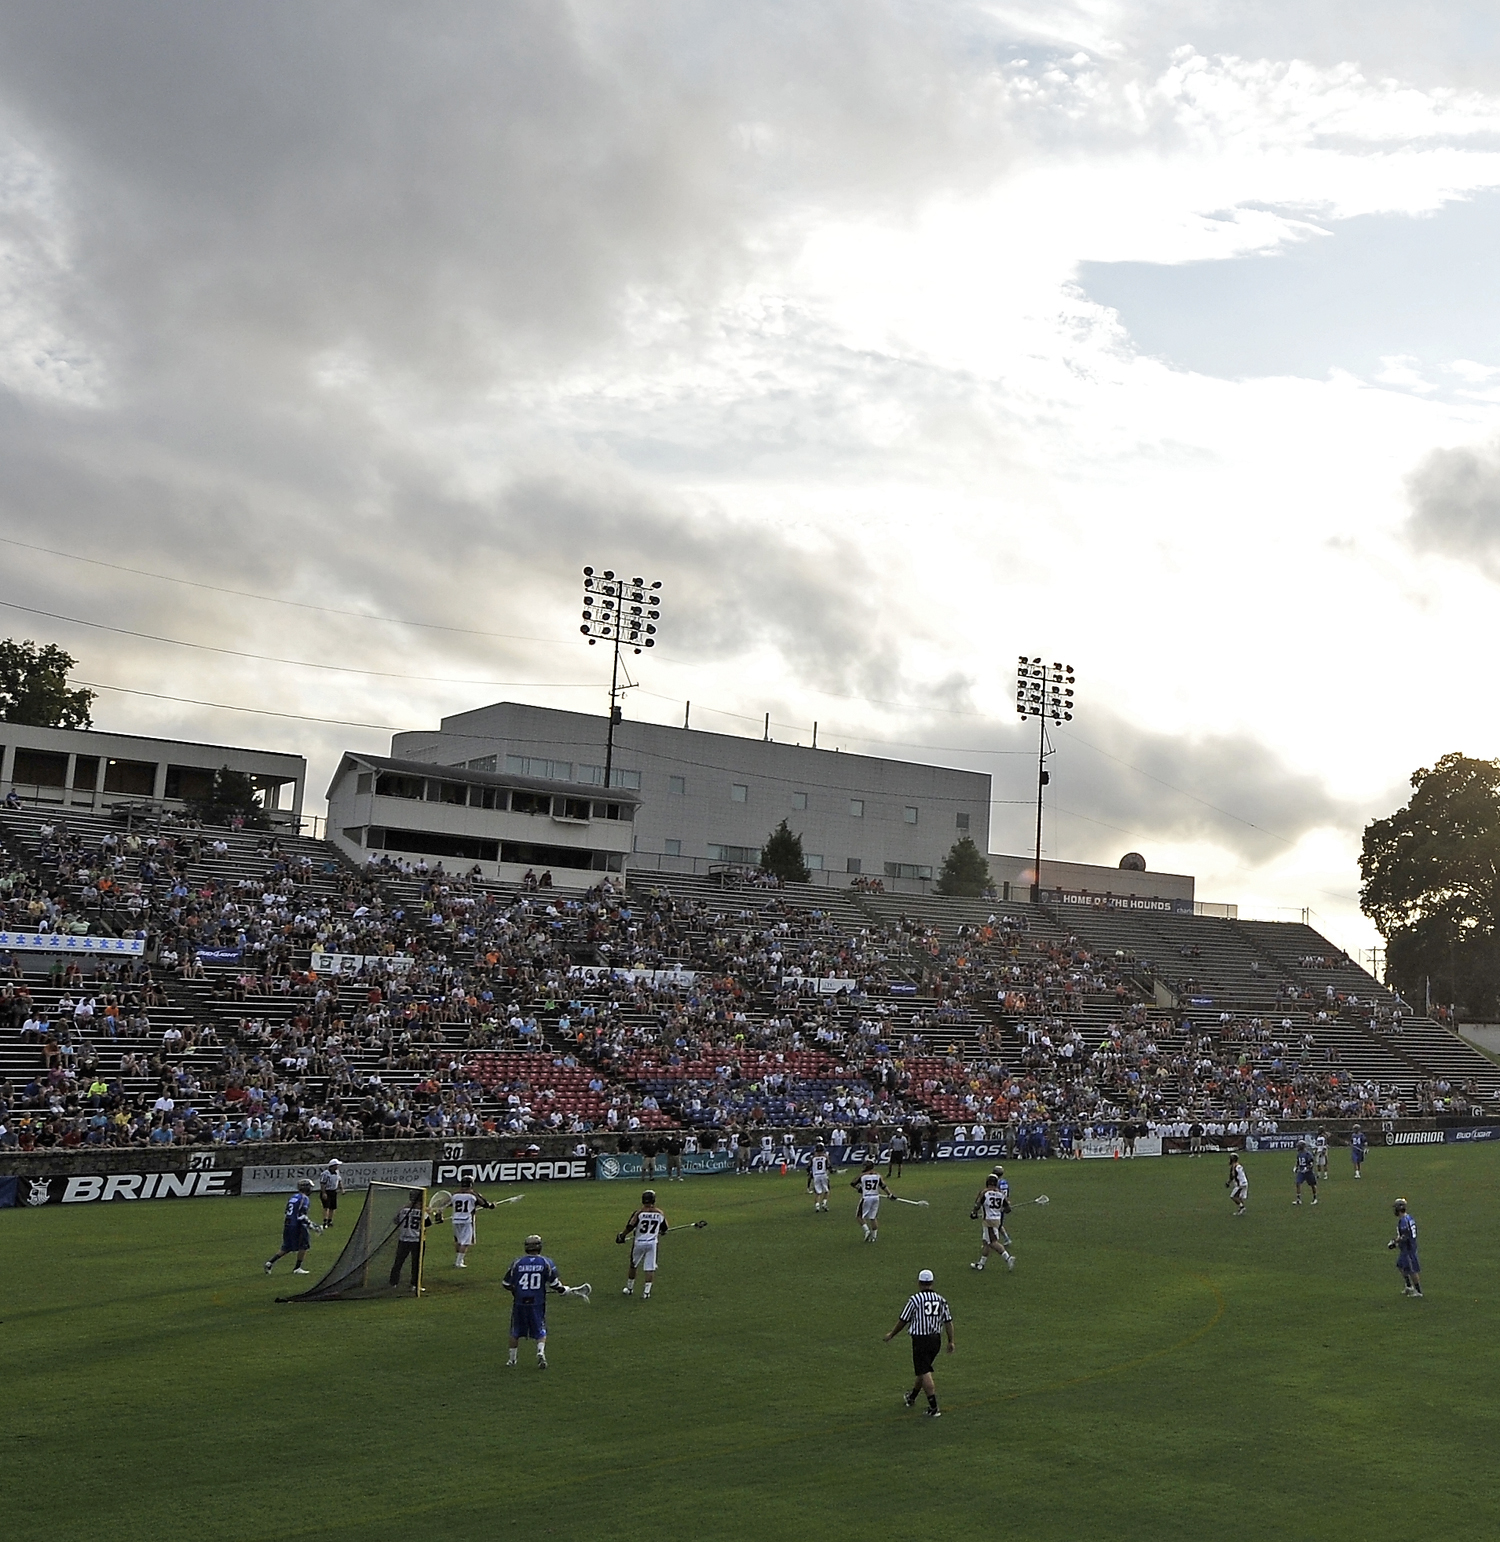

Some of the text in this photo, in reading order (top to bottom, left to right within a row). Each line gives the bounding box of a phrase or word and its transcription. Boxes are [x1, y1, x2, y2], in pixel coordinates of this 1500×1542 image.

[1063, 894, 1092, 905] HOME
[1110, 898, 1128, 908] THE
[1130, 900, 1171, 911] HOUNDS
[1394, 1131, 1444, 1144] WARRIOR
[443, 1147, 462, 1159] 30
[191, 1156, 212, 1169] 20
[339, 1168, 377, 1176] HONOR
[403, 1166, 427, 1175] MAN
[61, 1171, 233, 1203] BRINE
[455, 1200, 469, 1213] 21
[988, 1197, 1002, 1209] 33
[403, 1214, 420, 1229] 15
[639, 1220, 659, 1234] 37
[519, 1272, 541, 1290] 40
[924, 1301, 940, 1315] 37
